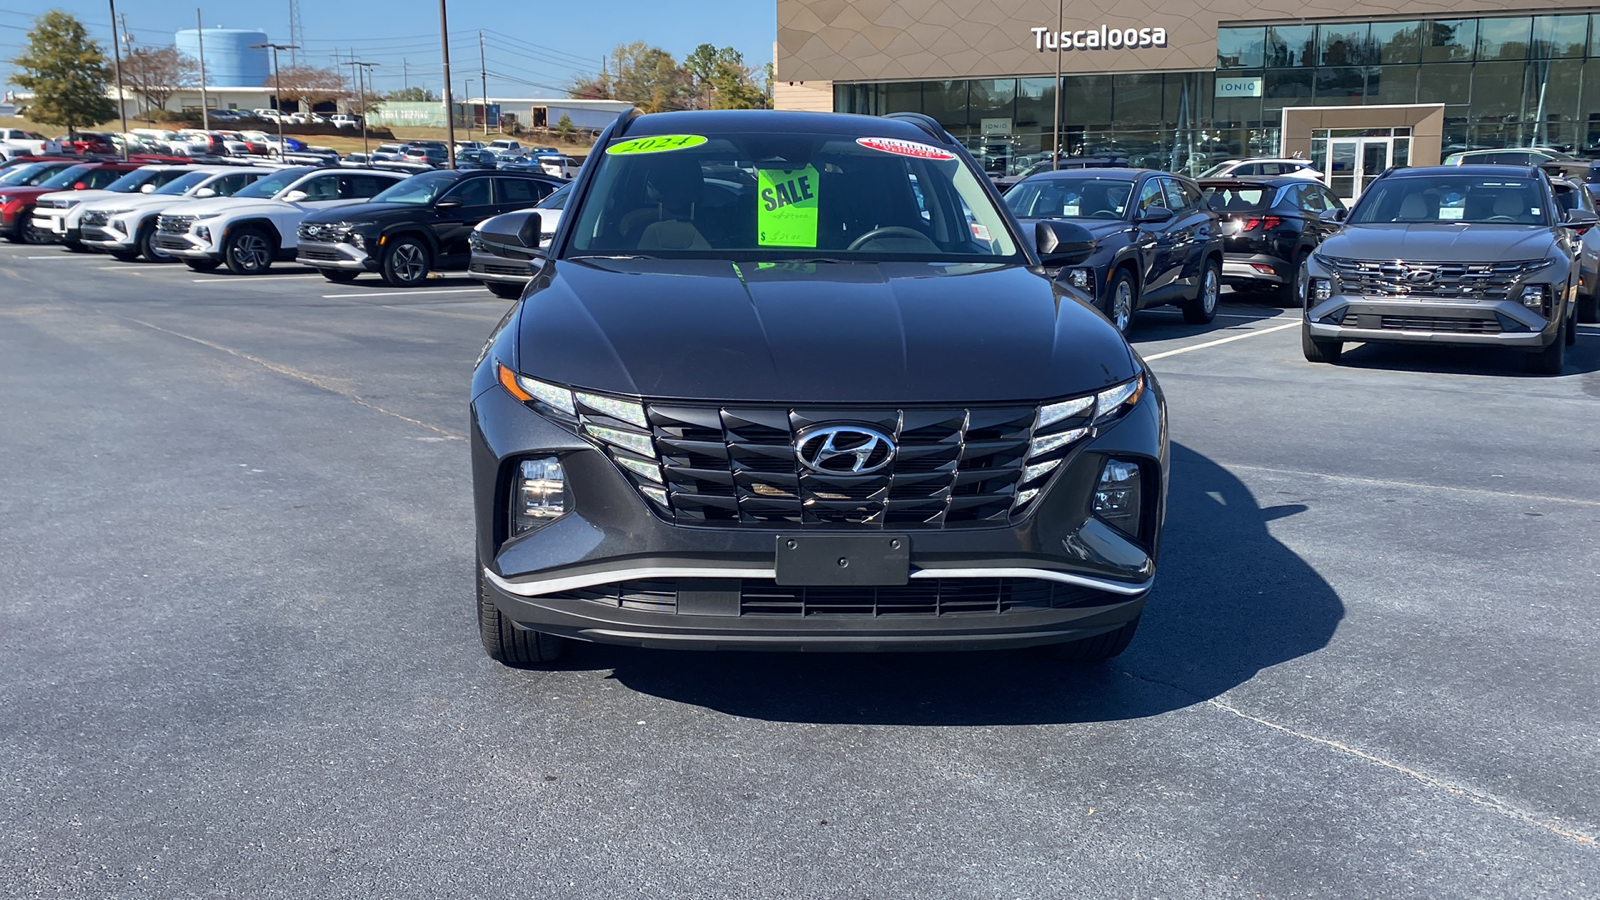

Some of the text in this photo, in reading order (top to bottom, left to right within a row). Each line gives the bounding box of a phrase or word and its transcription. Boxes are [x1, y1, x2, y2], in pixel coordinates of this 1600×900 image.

[1030, 24, 1166, 50] Tuscaloosa
[621, 135, 692, 153] 2024
[761, 175, 814, 212] SALE
